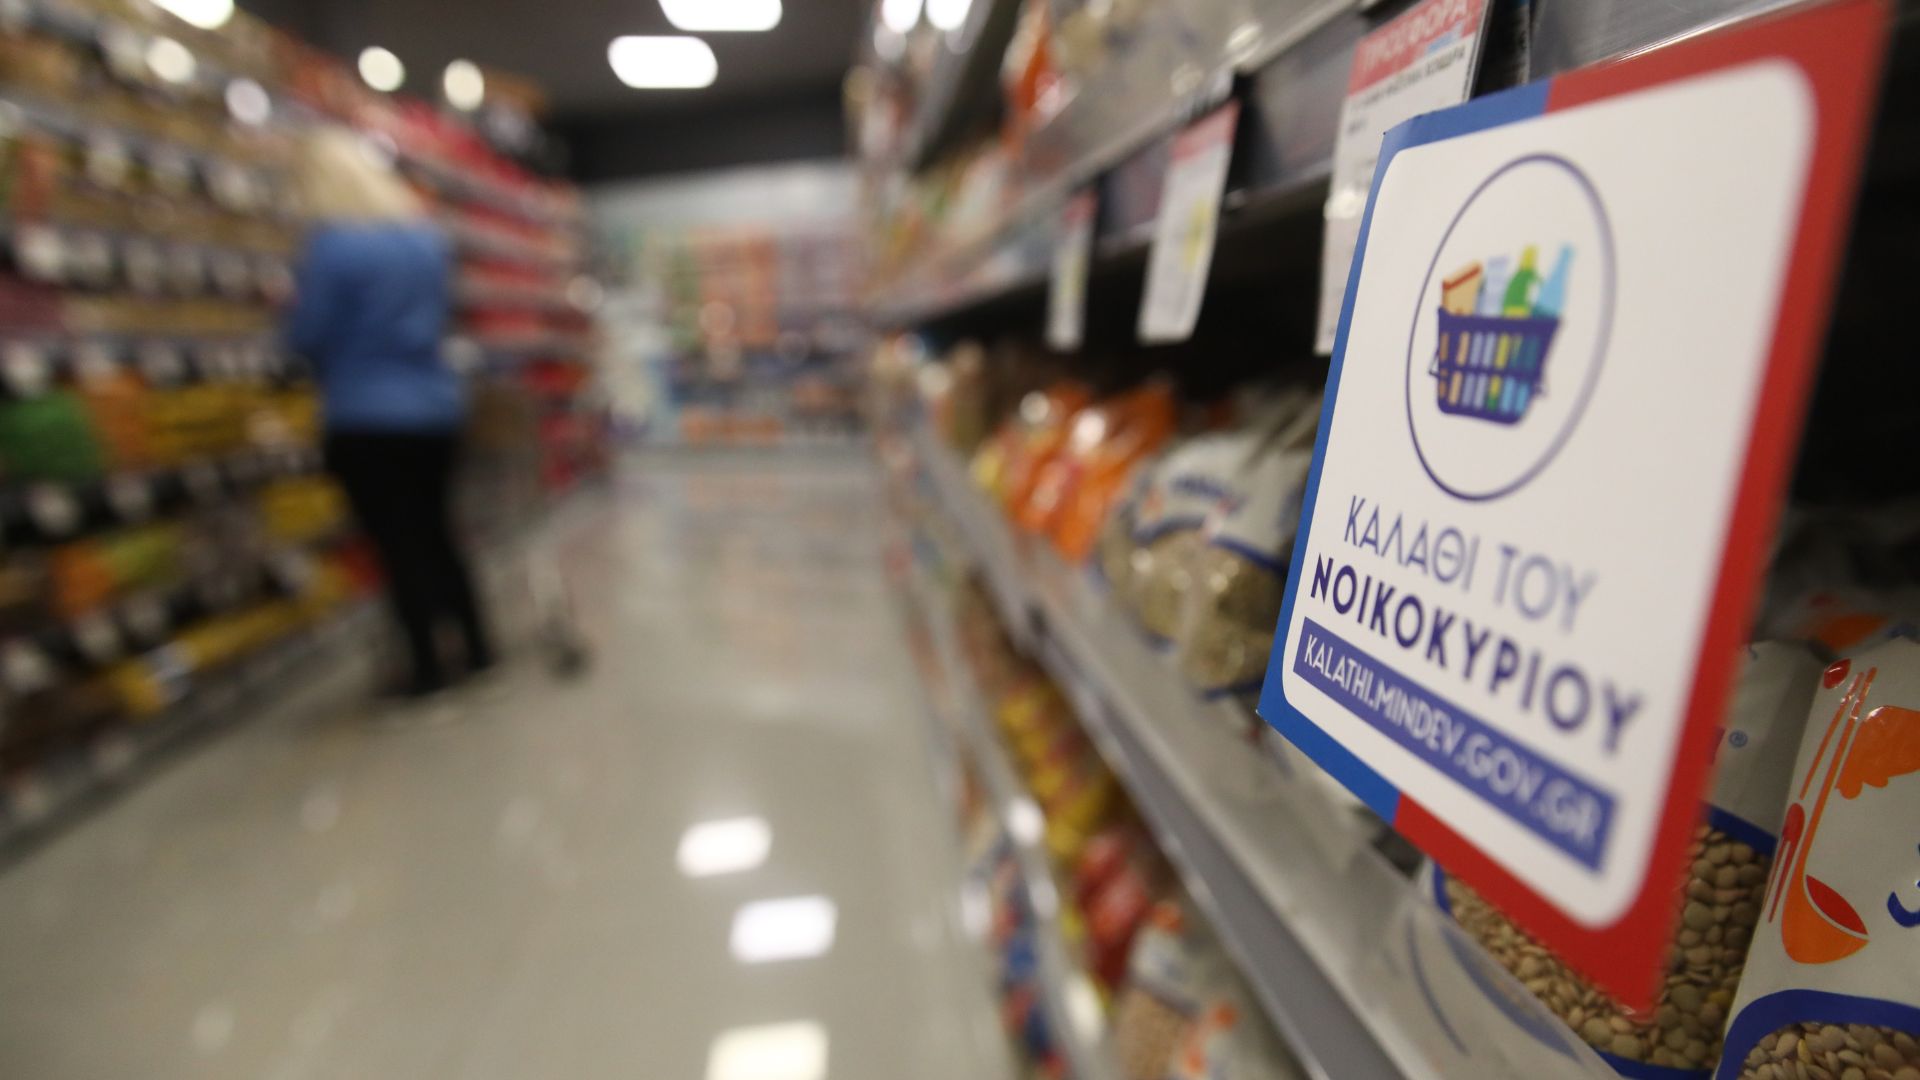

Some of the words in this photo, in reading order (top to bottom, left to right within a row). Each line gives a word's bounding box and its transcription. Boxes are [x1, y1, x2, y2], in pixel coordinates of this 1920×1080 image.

[1310, 554, 1645, 753] ΝΟΙΚΟΚΥΡΙΟΥ
[1344, 495, 1479, 591] ΚΑΛΑΘΙ
[1492, 544, 1599, 631] ΤΟΥ
[1304, 634, 1603, 843] KALATHI.MINDEV.GOV.GR
